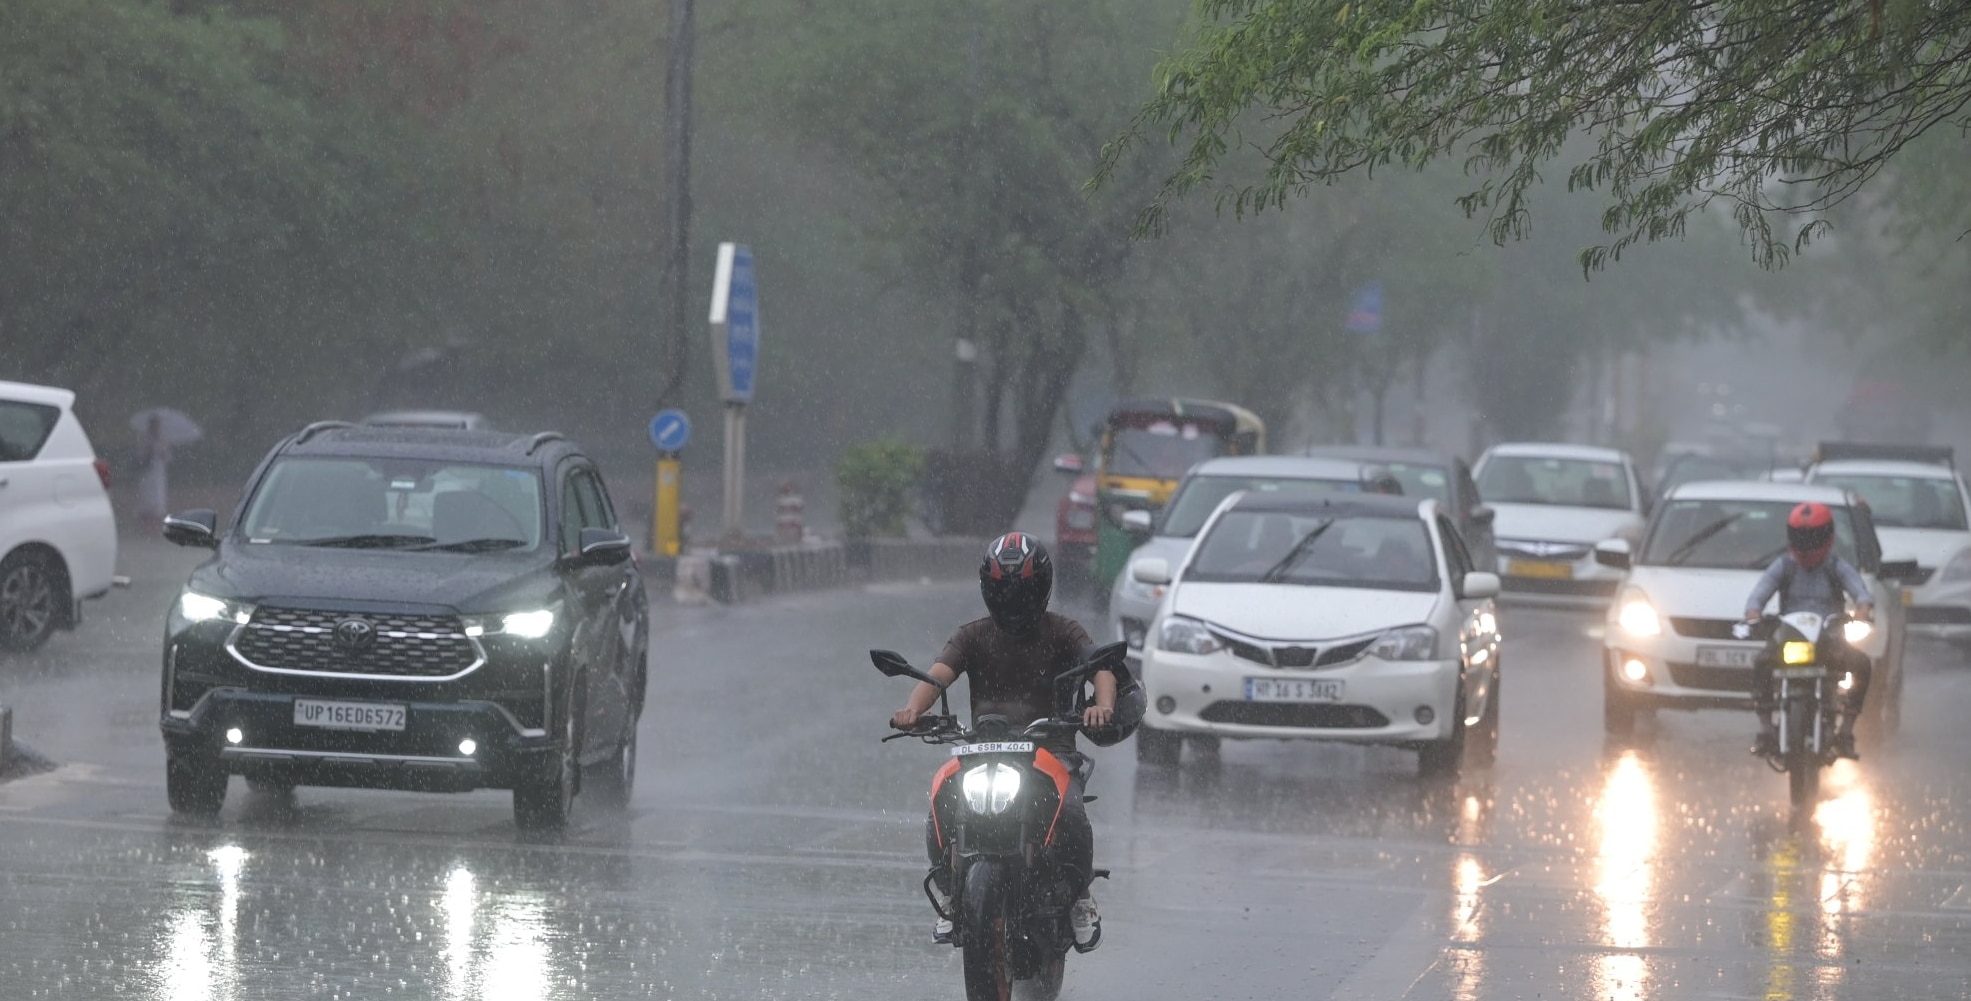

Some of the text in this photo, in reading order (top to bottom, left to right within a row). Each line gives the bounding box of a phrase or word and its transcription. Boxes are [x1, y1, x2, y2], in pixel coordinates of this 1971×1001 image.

[305, 704, 404, 727] UP16ED6572
[961, 743, 1031, 754] DL 6SBM 4041
